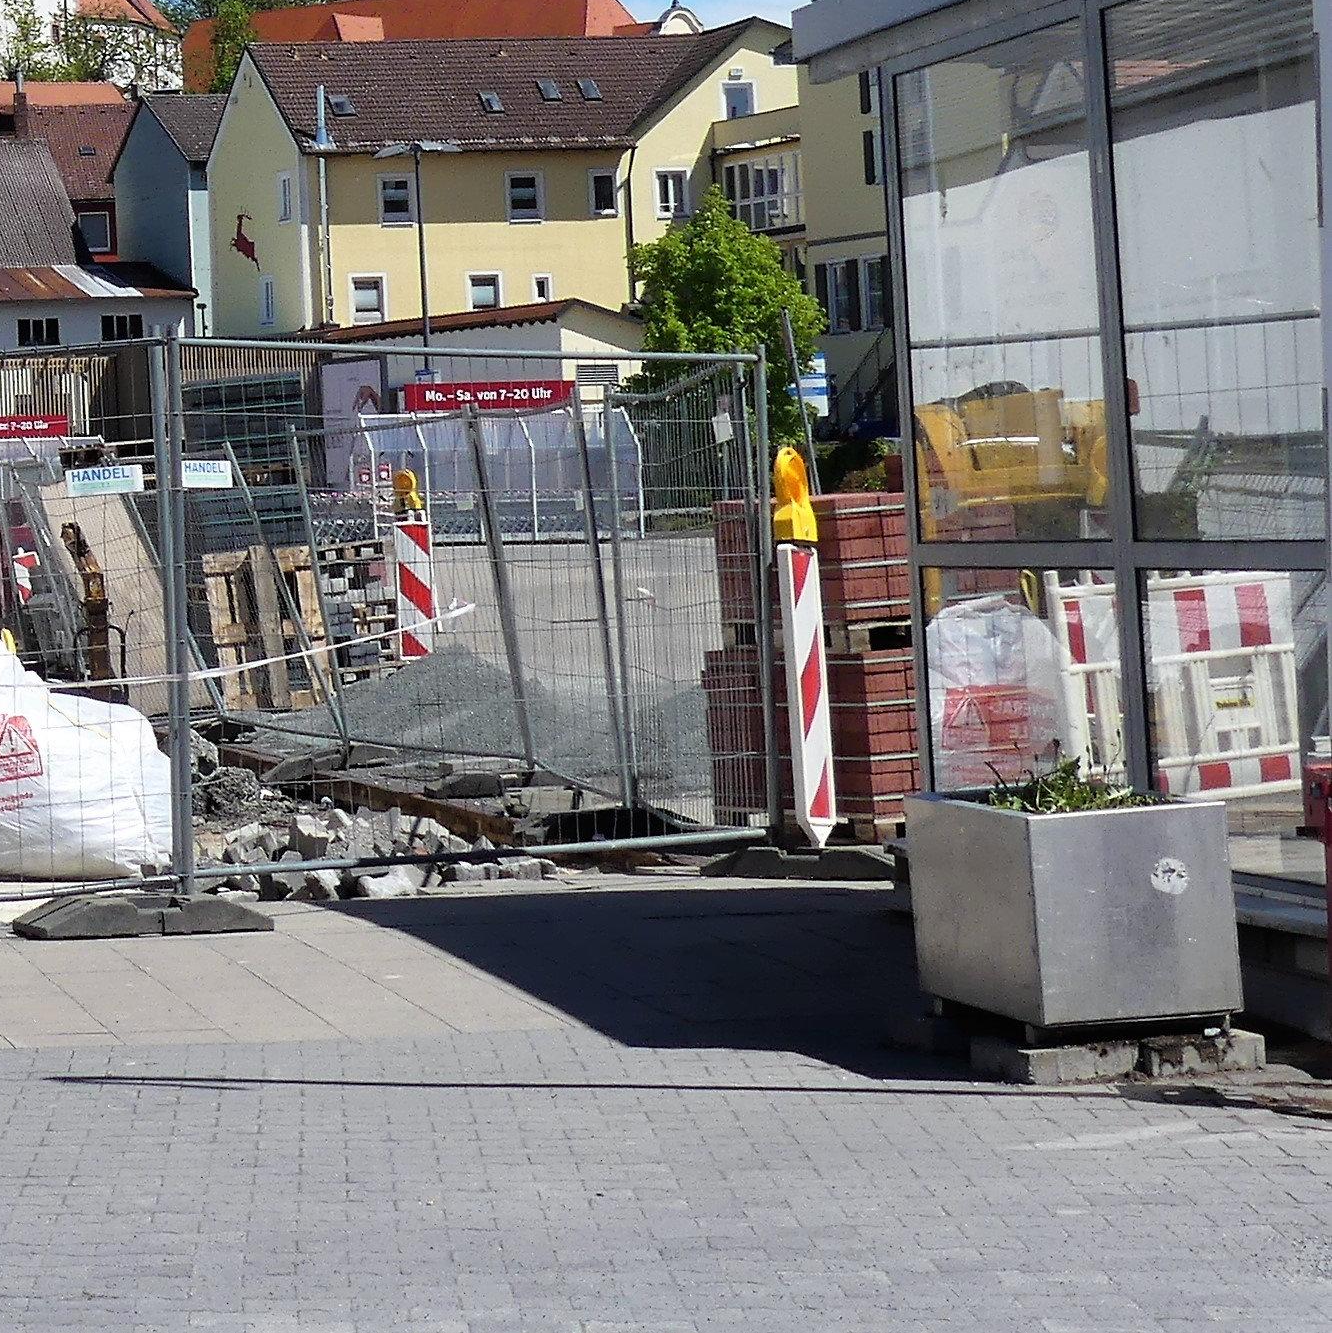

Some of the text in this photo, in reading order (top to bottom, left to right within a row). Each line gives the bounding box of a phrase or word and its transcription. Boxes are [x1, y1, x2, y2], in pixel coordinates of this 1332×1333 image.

[476, 391, 497, 401] von
[531, 387, 553, 400] Uhr
[184, 461, 225, 474] HANDEL
[70, 467, 130, 483] HANDEL
